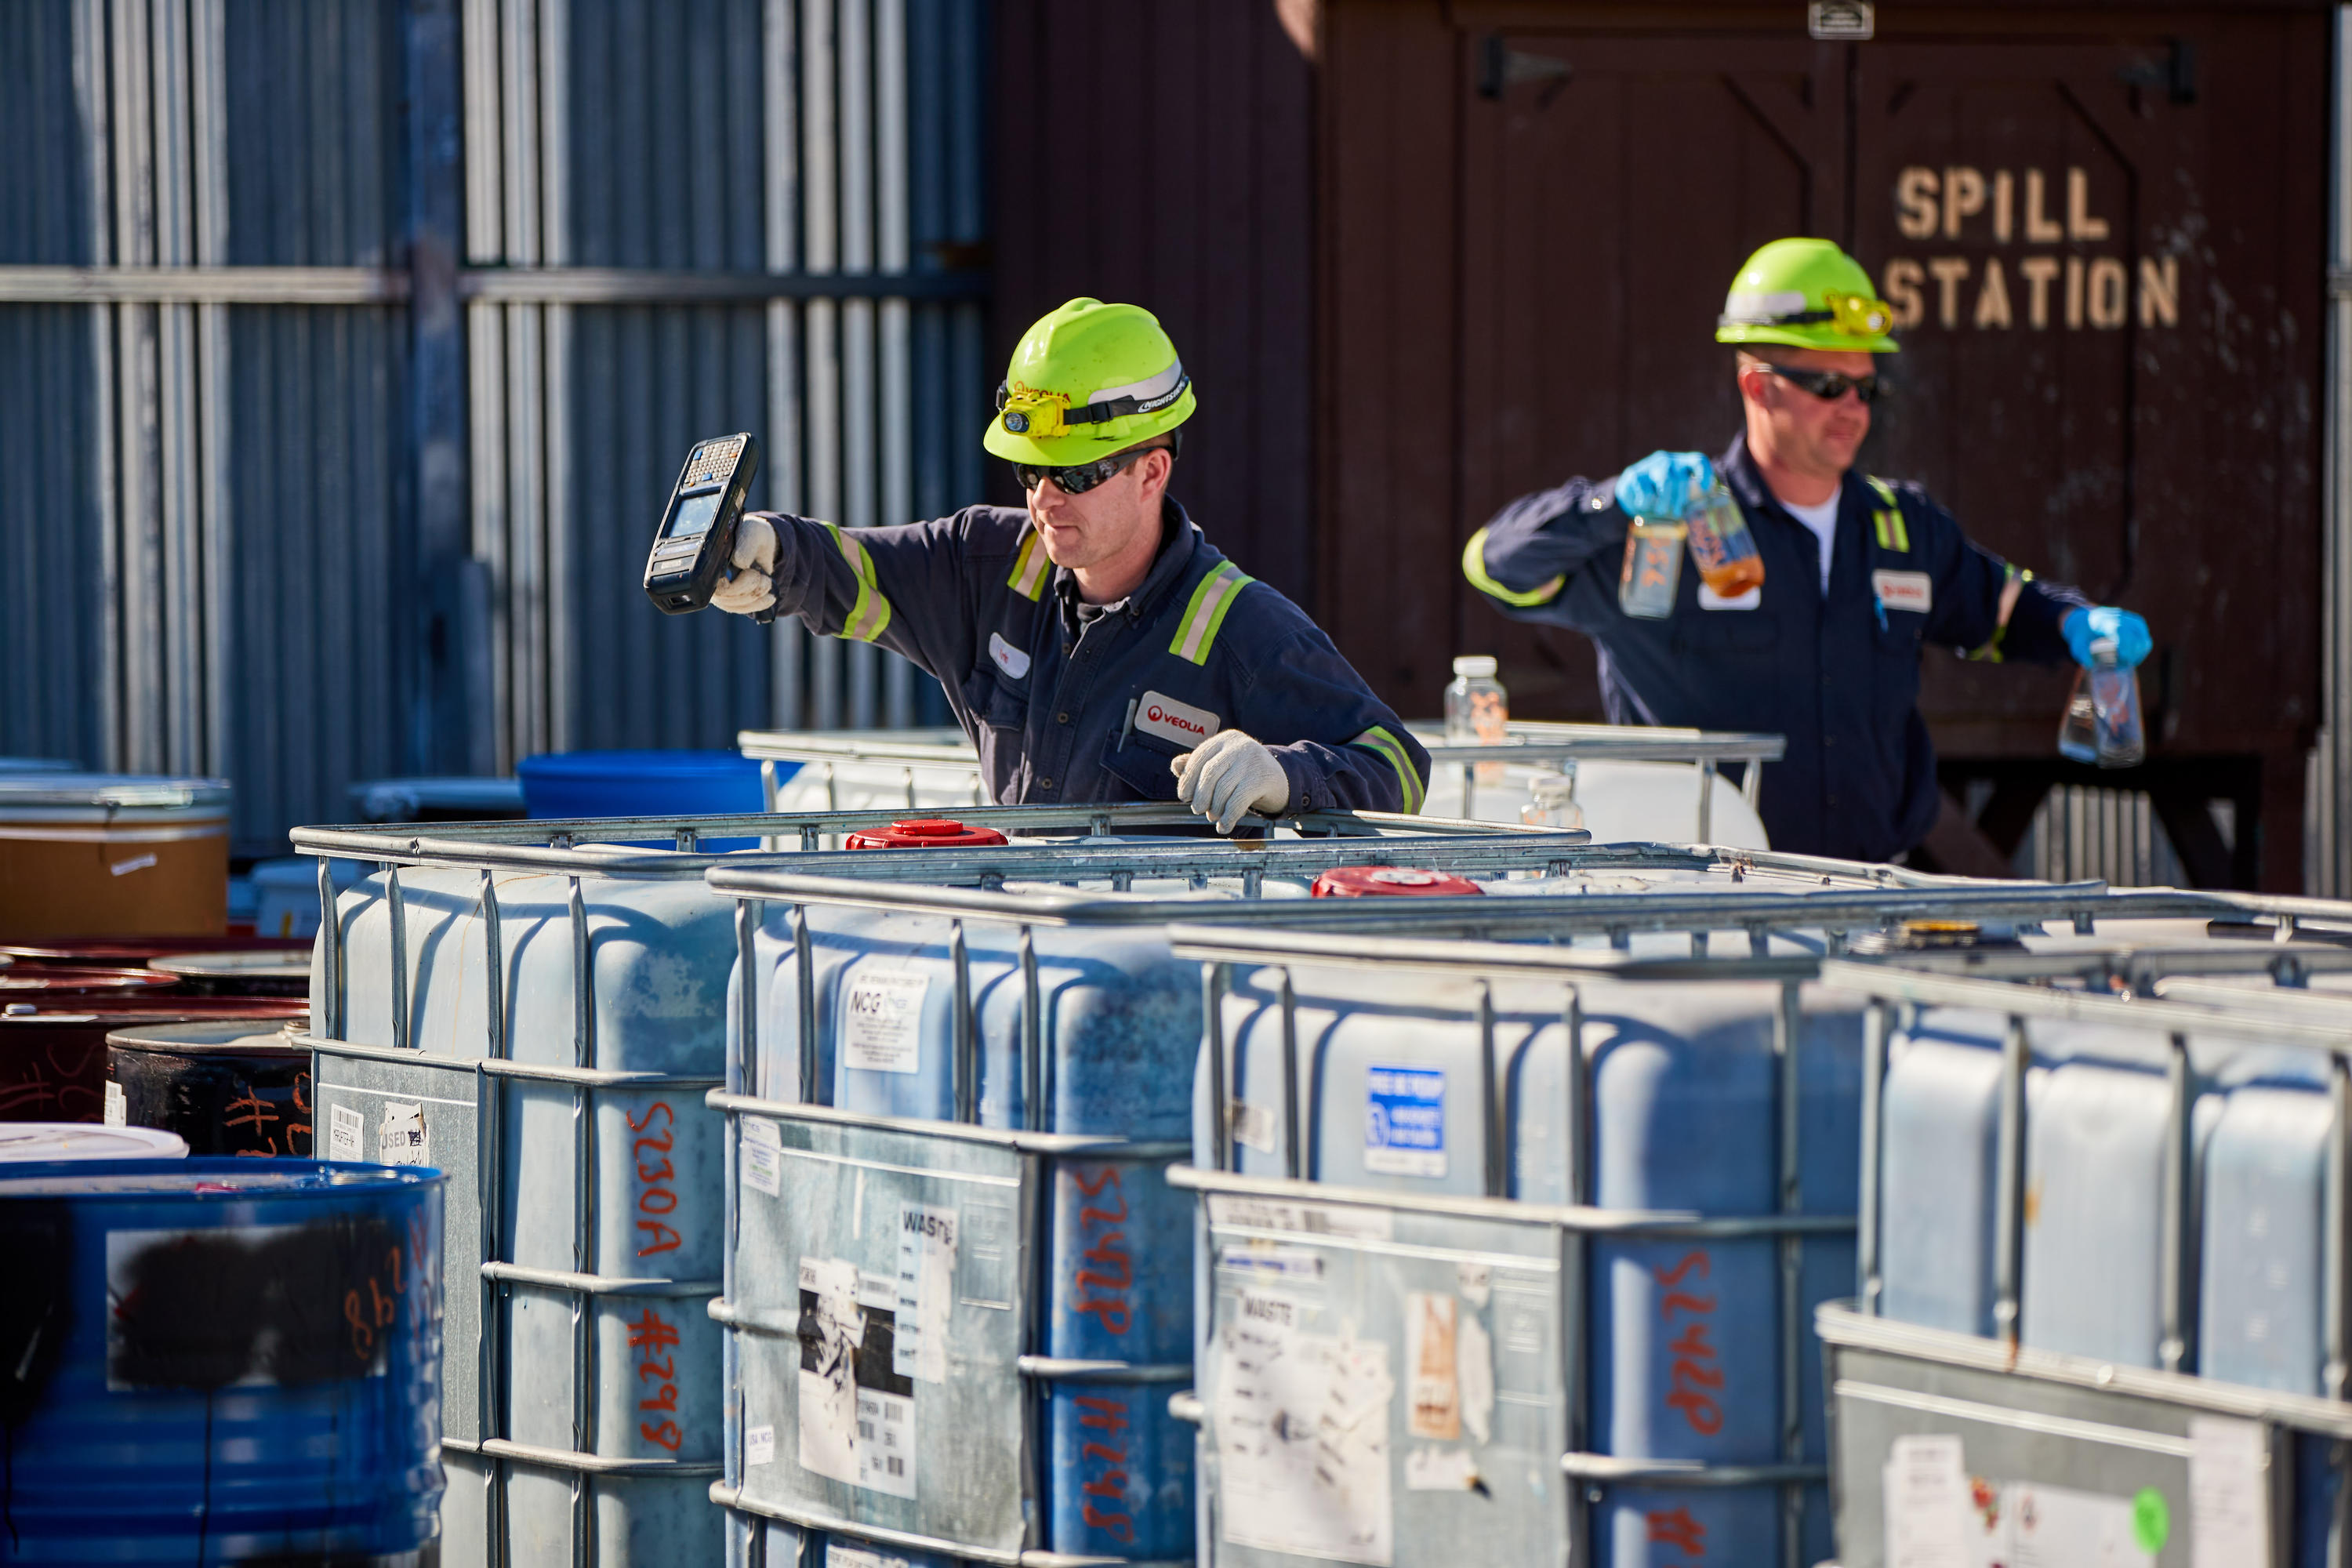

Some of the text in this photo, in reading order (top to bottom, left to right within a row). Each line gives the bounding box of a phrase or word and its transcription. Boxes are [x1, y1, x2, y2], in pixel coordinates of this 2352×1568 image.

[1896, 165, 2110, 244] SPILL
[1884, 254, 2180, 332] STATION
[1164, 713, 1205, 735] VEOLIA
[851, 991, 881, 1014] NCG
[382, 1130, 406, 1150] USED
[626, 1101, 681, 1257] S230A
[1075, 1168, 1133, 1334] S242P
[626, 1308, 682, 1452] #298
[1653, 1248, 1725, 1436] S242P
